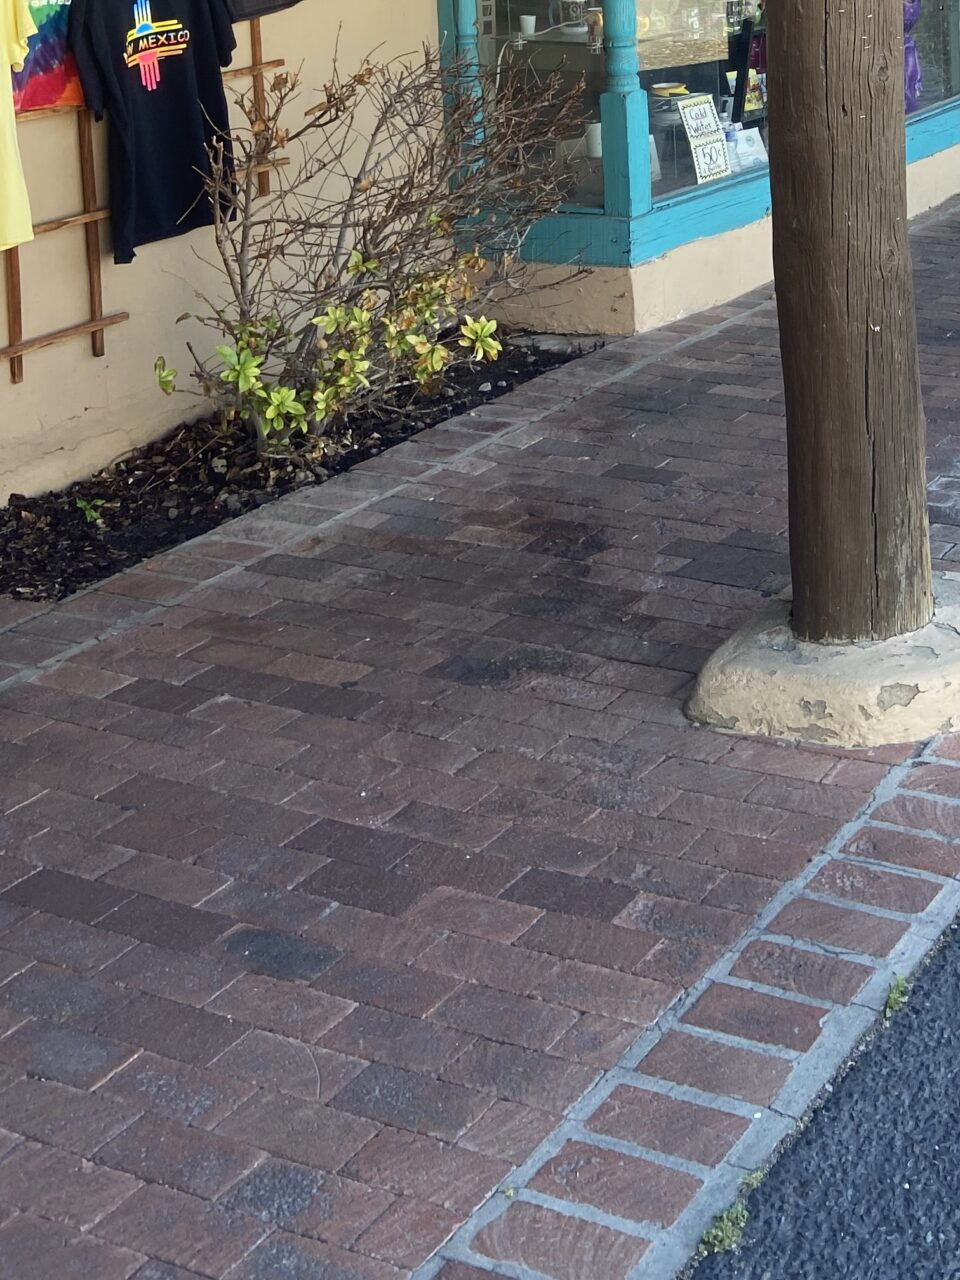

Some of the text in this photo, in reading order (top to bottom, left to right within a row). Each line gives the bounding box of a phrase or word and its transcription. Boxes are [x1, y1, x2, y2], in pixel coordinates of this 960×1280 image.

[139, 29, 190, 52] MEXICO
[689, 106, 707, 121] Cold
[690, 120, 712, 134] Water
